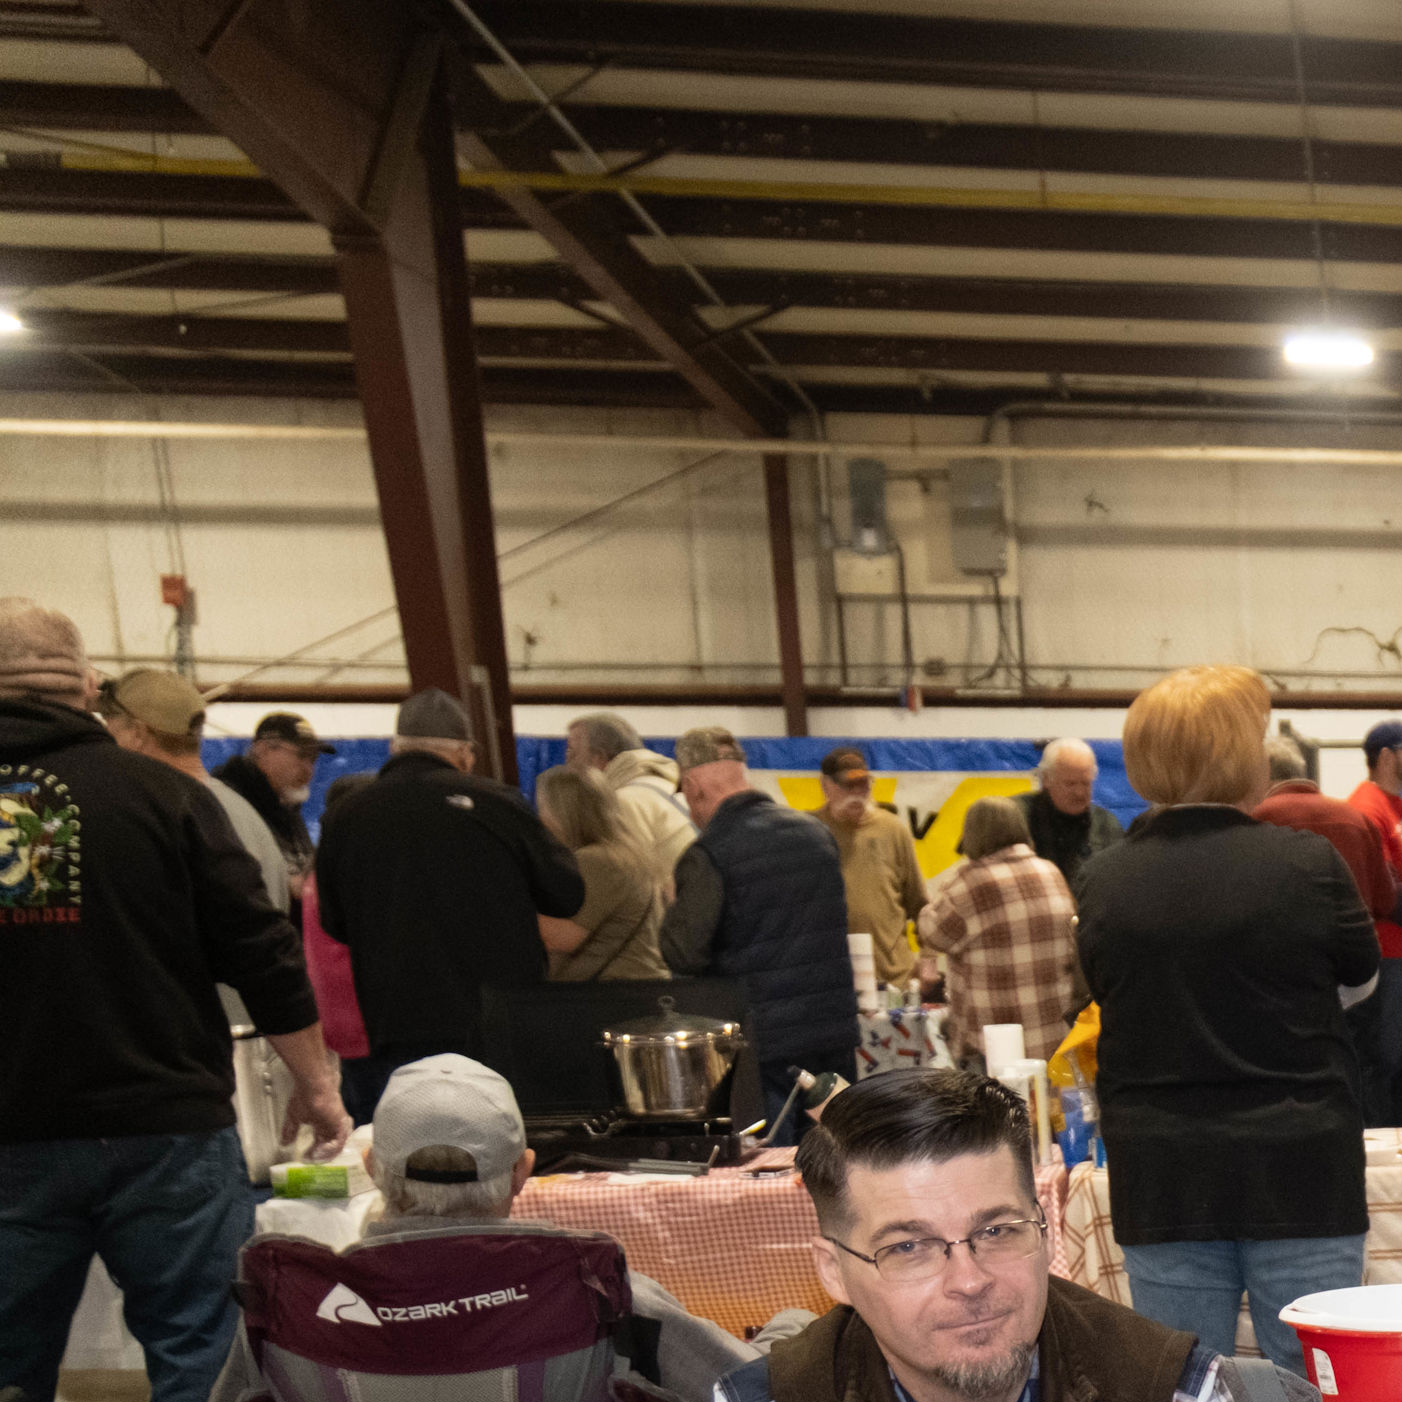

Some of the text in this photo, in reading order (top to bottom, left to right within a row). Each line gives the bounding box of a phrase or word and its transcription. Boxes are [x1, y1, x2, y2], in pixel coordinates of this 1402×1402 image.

[0, 764, 69, 796] OFFEE
[376, 1286, 529, 1322] OZARK TRAIL
